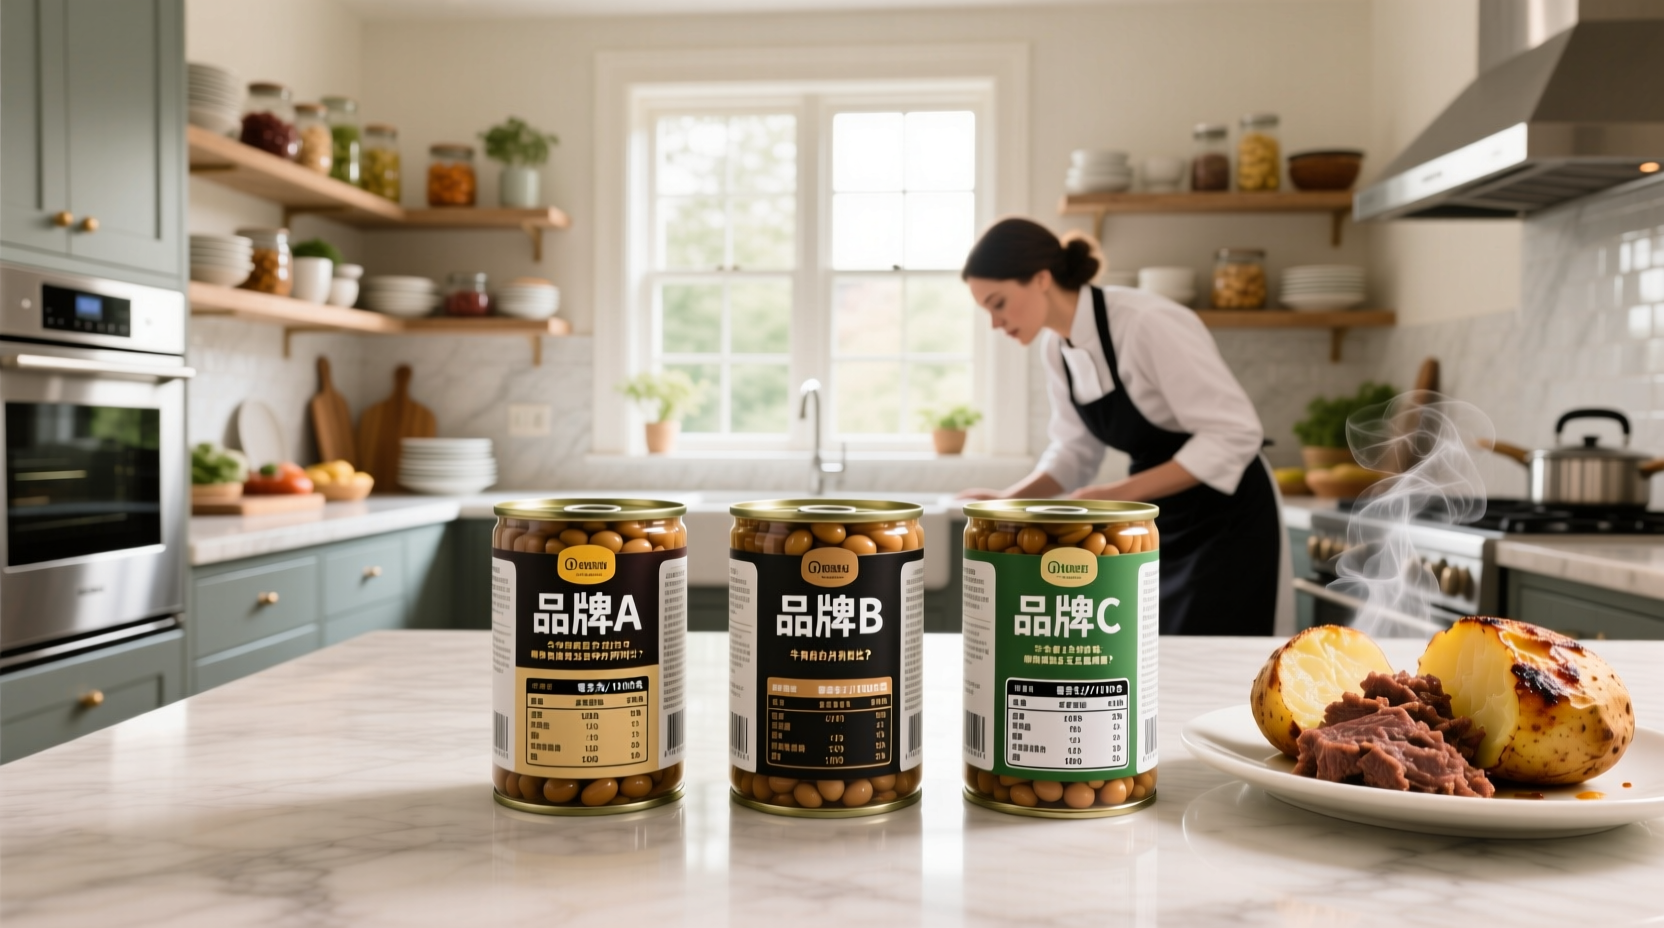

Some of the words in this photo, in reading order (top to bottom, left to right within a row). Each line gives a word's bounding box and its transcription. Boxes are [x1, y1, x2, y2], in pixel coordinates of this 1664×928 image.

[533, 591, 643, 636] 品牌A
[776, 593, 884, 639] 品牌B
[1014, 594, 1122, 638] 品牌C
